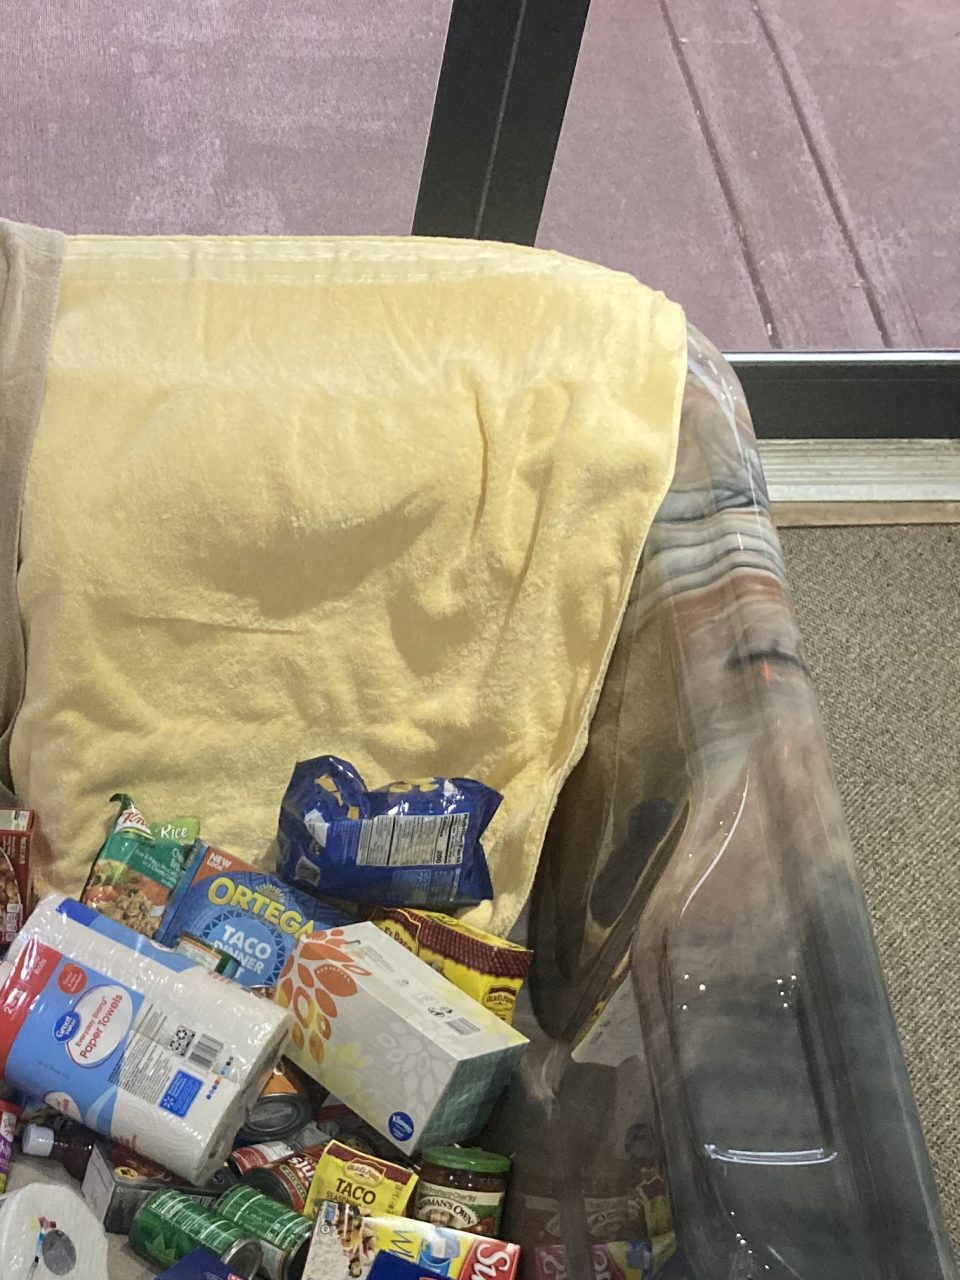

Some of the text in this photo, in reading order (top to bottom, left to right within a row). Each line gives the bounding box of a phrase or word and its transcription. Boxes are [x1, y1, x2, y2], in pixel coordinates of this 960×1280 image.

[160, 824, 189, 840] Rice
[207, 852, 232, 868] NEW
[208, 877, 315, 937] ORTEGA
[221, 924, 272, 960] TACO
[56, 1016, 74, 1040] Great
[74, 1017, 98, 1048] Everyday
[80, 993, 123, 1059] Paper Towels
[335, 1177, 377, 1205] TACO
